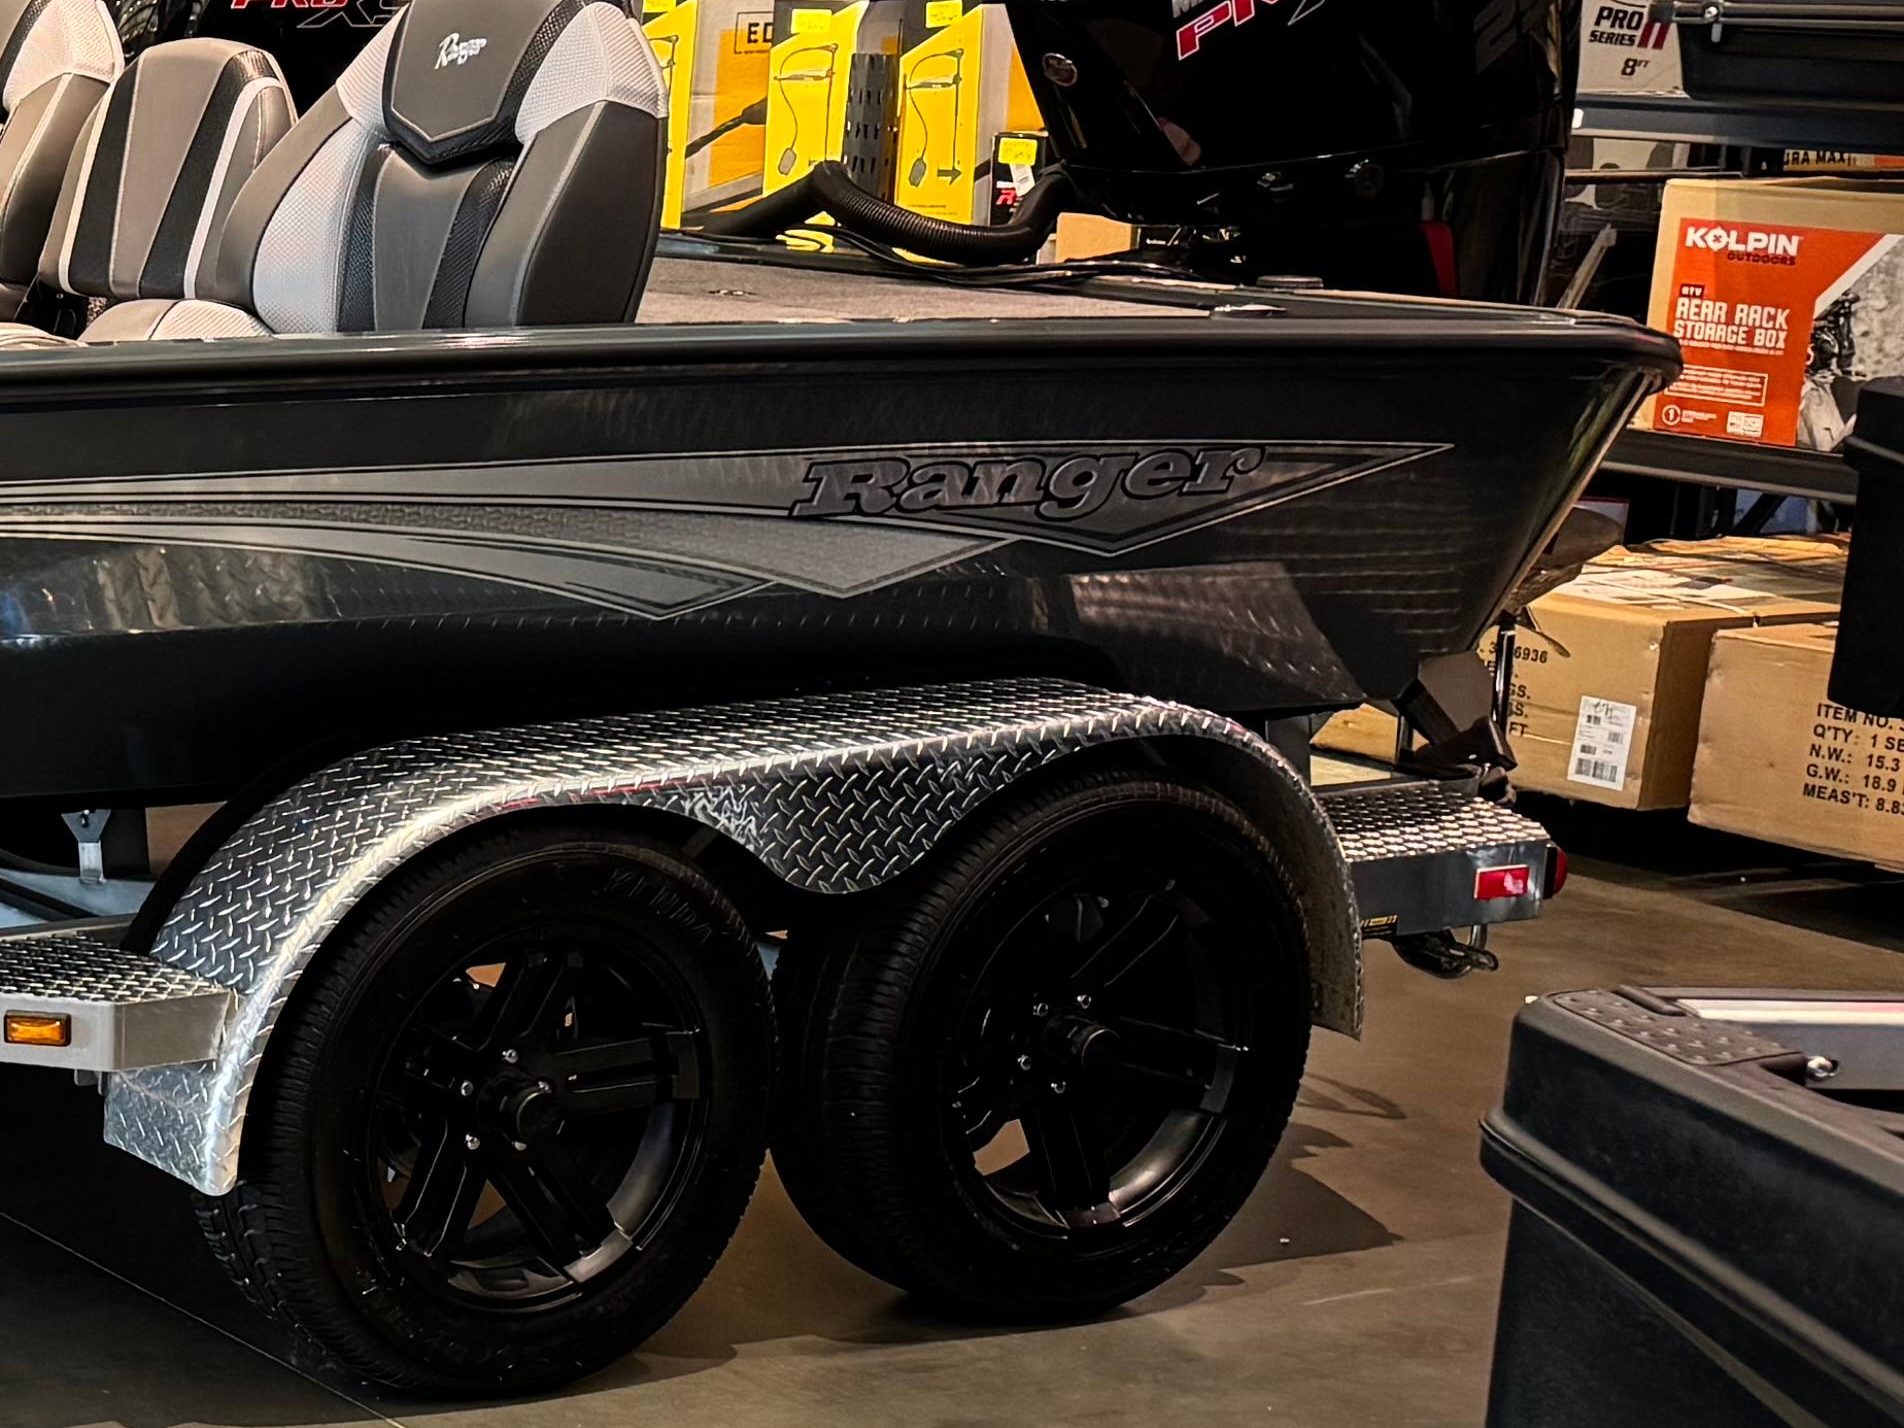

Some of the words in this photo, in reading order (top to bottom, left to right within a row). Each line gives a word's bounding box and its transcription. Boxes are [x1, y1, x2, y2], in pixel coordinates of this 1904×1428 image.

[1594, 5, 1645, 32] PRO
[1588, 30, 1638, 48] SERIES
[1685, 226, 1800, 256] KOLPIN
[1726, 252, 1797, 267] OUTDOORS
[1675, 297, 1728, 321] REAR
[1734, 303, 1792, 330] RACK
[1673, 319, 1748, 345] STORAGE
[1753, 328, 1789, 350] BOX
[792, 444, 1268, 524] Ranger
[1817, 703, 1858, 724] ITEM
[1870, 733, 1878, 749] 1
[1809, 743, 1852, 764] N.W.:
[1867, 753, 1901, 773] 15.3
[1806, 763, 1850, 785] G.W.:
[1863, 773, 1897, 794] 18.9
[1802, 782, 1871, 809] MEAS'T:
